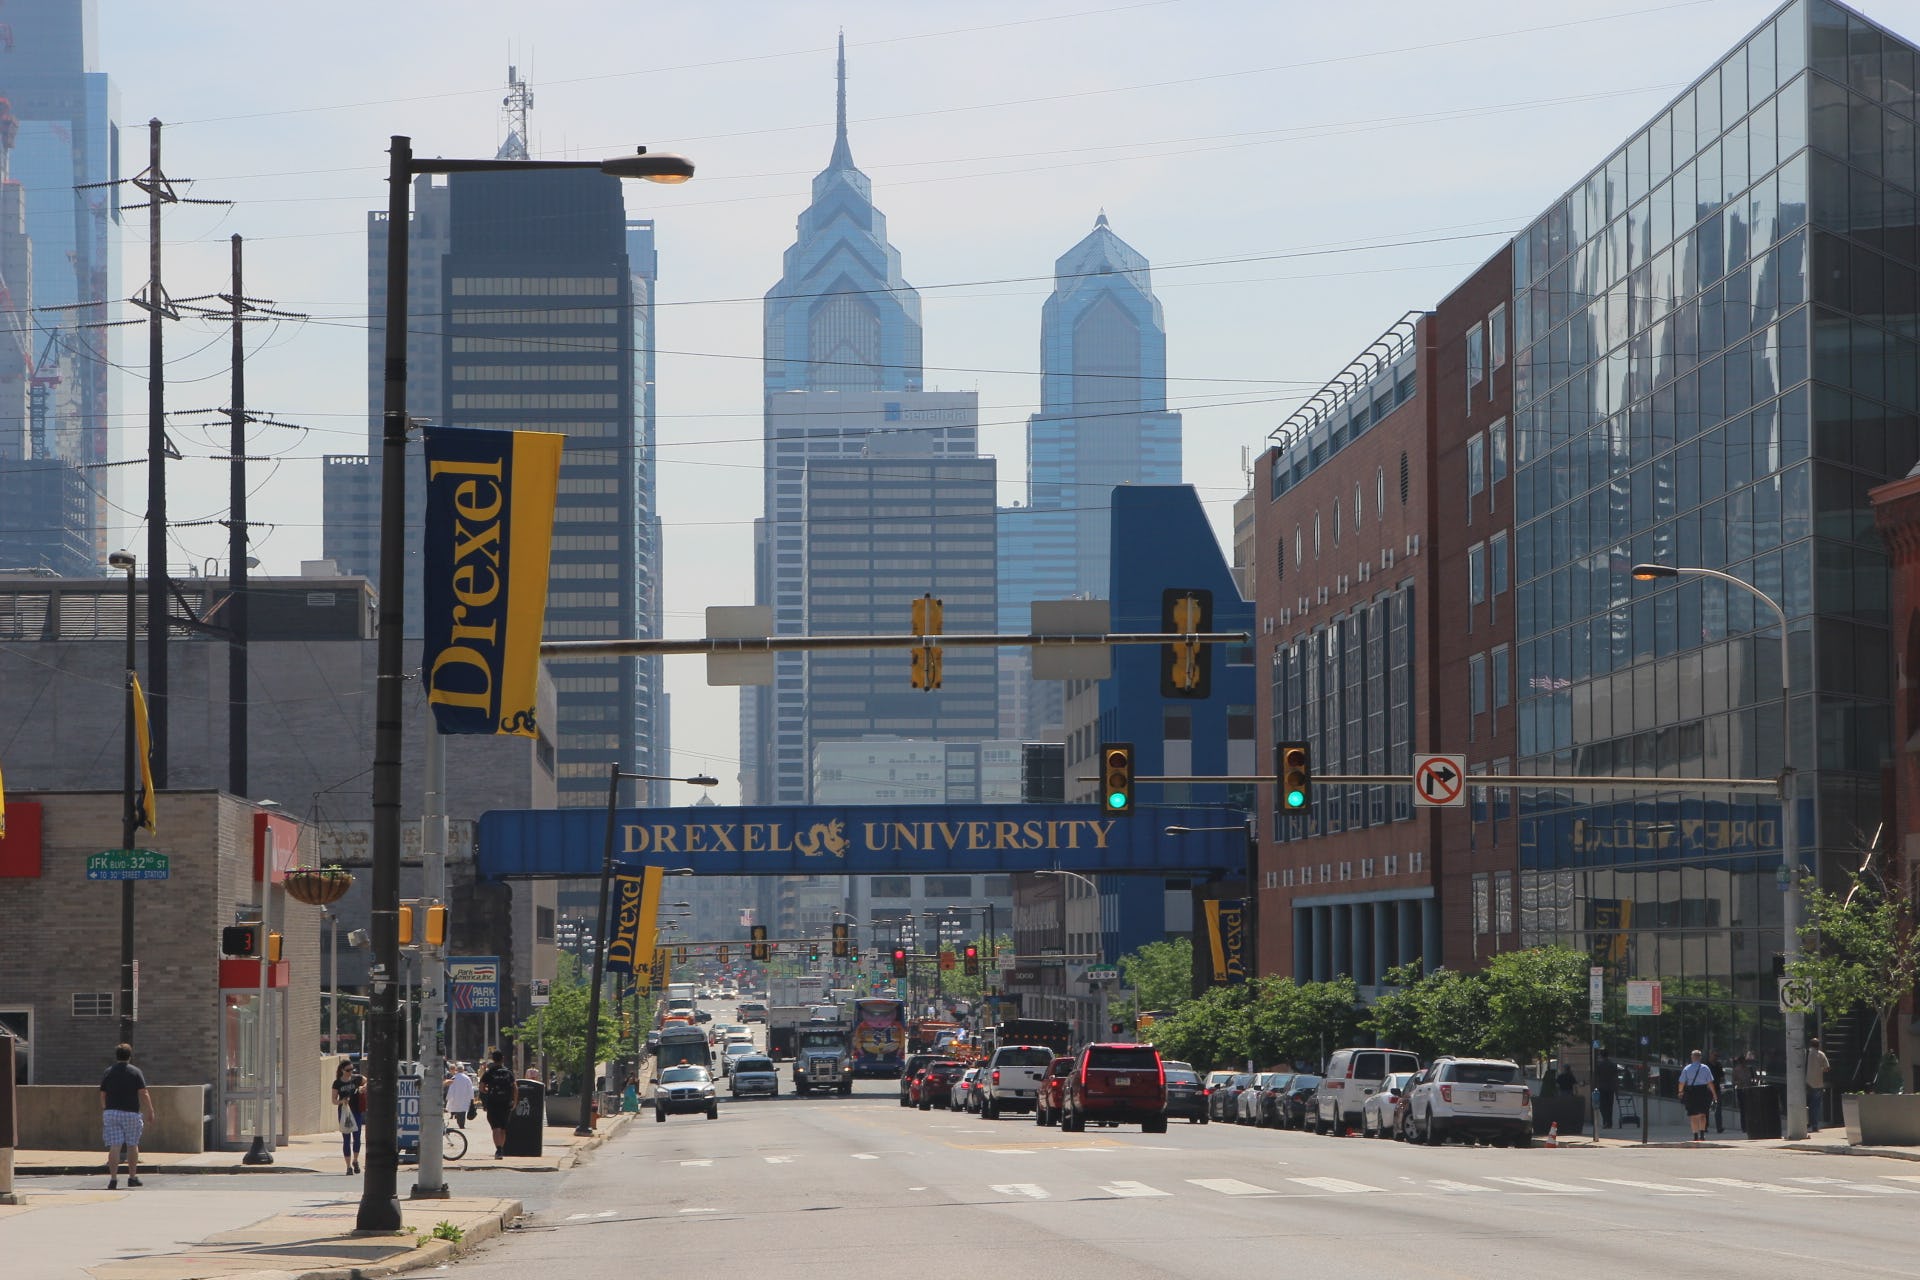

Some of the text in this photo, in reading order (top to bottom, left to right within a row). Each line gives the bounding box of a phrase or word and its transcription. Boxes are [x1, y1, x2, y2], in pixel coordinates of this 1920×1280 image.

[428, 456, 503, 719] Drexel
[622, 820, 1116, 853] DREXEL UNIVERSITY
[89, 857, 108, 869] JFK
[157, 860, 166, 869] ST
[100, 871, 107, 879] TO
[121, 871, 141, 879] STREET
[143, 871, 167, 879] STATION
[608, 874, 642, 965] Drexel
[1220, 908, 1244, 976] Drexel
[457, 968, 473, 977] Park
[472, 986, 495, 997] PARK
[472, 997, 497, 1007] HERE
